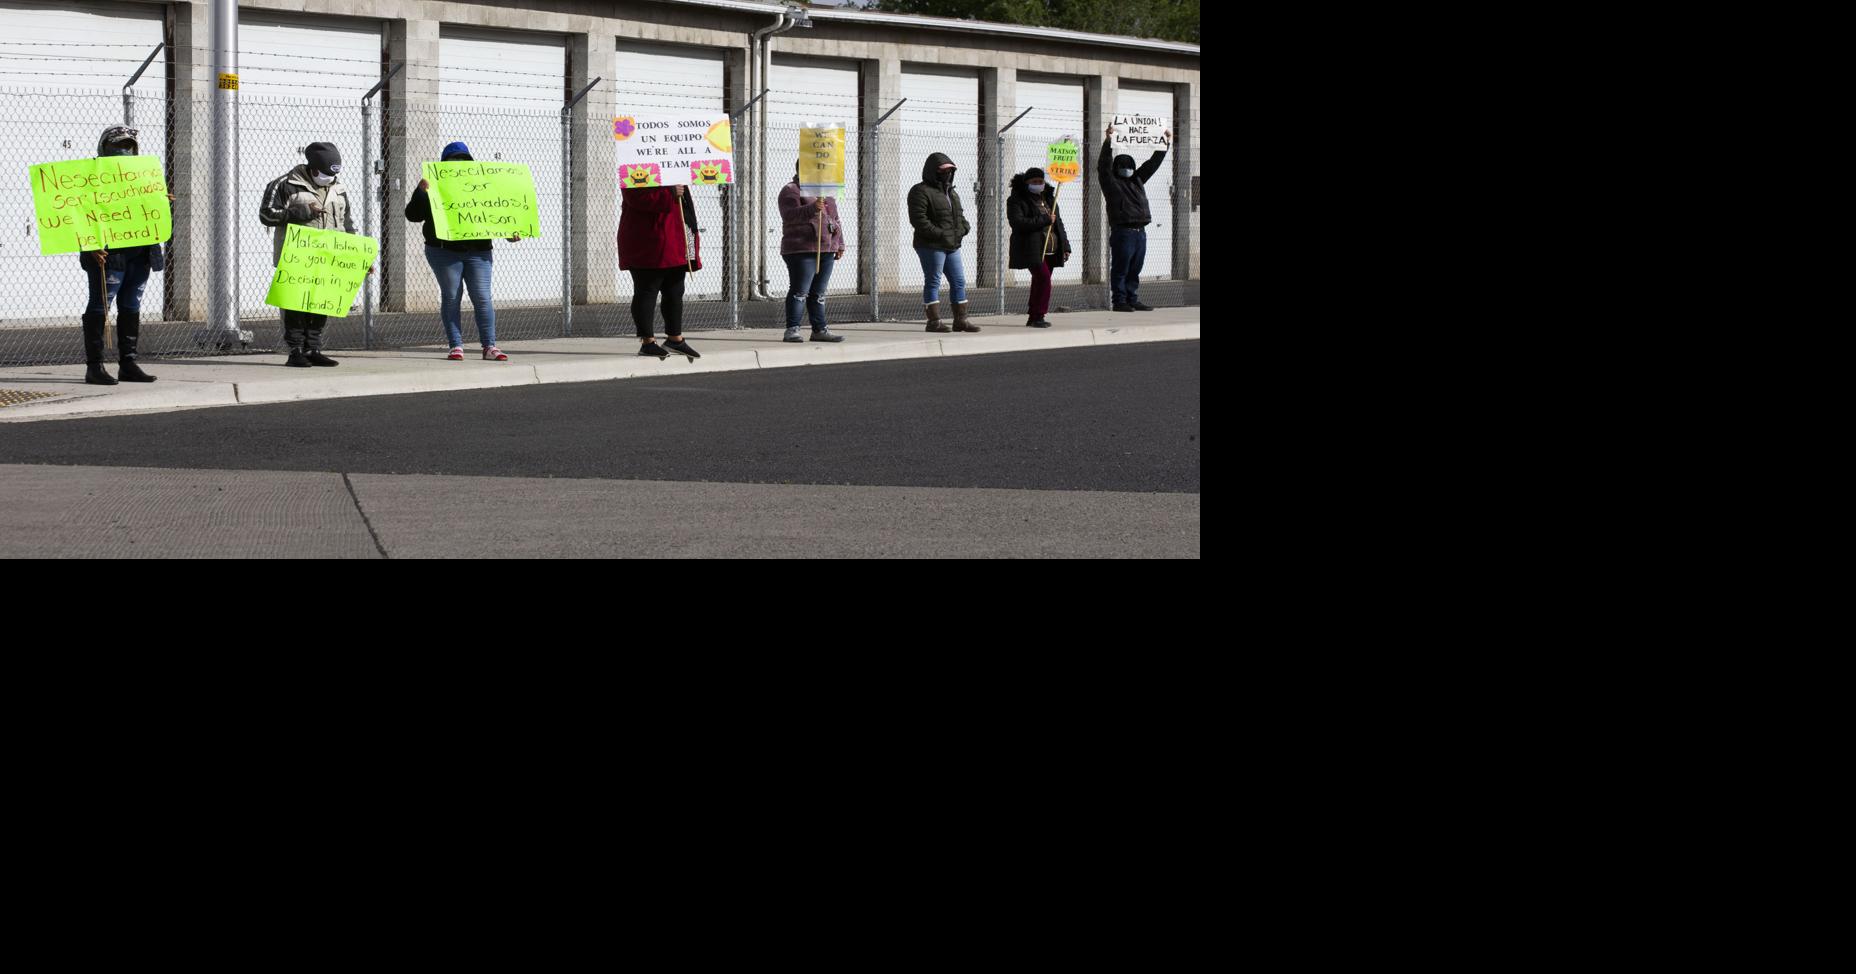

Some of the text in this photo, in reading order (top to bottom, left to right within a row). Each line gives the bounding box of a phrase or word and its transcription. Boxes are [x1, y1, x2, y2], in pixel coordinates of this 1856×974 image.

[636, 120, 711, 130] TODOS SOMOS
[1114, 115, 1128, 125] LA
[1129, 126, 1149, 134] HACE
[641, 133, 703, 143] UN EQUIPO
[62, 139, 72, 149] 45
[813, 141, 834, 149] CAN
[636, 145, 669, 156] WE'RE
[677, 147, 697, 155] ALL
[815, 151, 830, 159] DO
[1053, 154, 1073, 162] FRUIT
[660, 160, 690, 169] TEAM
[86, 206, 132, 226] Need
[141, 204, 161, 221] to
[304, 255, 327, 269] you
[330, 274, 341, 286] in
